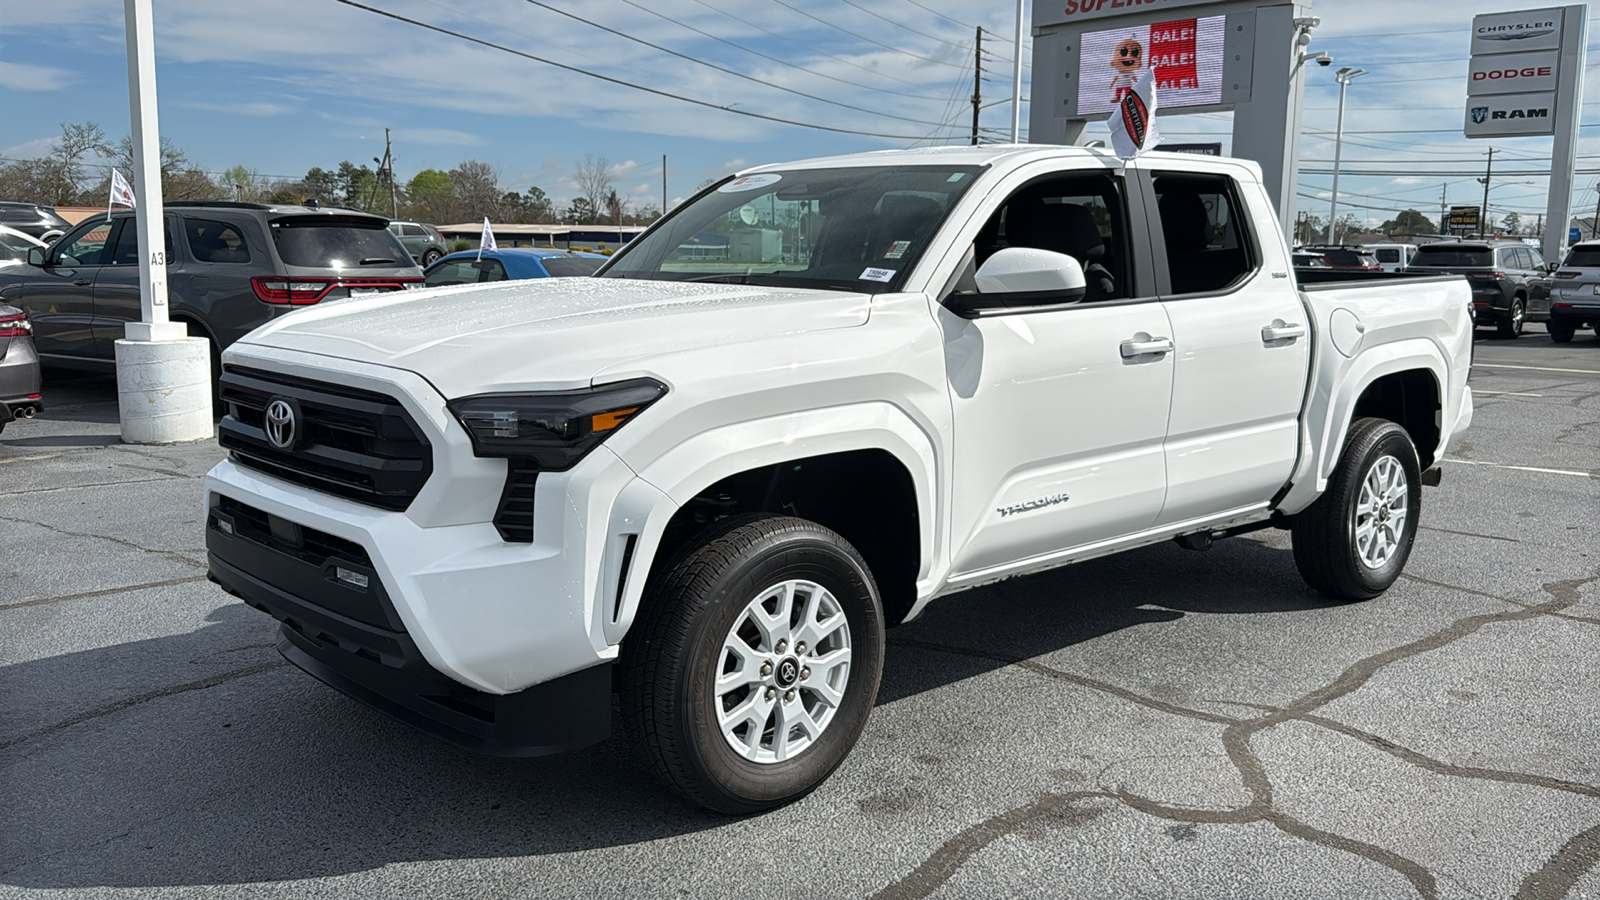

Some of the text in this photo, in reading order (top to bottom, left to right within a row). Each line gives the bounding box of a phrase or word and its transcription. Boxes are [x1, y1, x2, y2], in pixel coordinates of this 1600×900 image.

[1478, 21, 1554, 33] CHRYSLER
[1152, 27, 1194, 43] SALE!
[1150, 52, 1194, 67] SALE!
[1472, 66, 1552, 81] DODGE
[1157, 77, 1195, 89] ALE!
[1491, 108, 1548, 120] RAM
[151, 252, 164, 266] A3
[997, 492, 1070, 517] TACOMA
